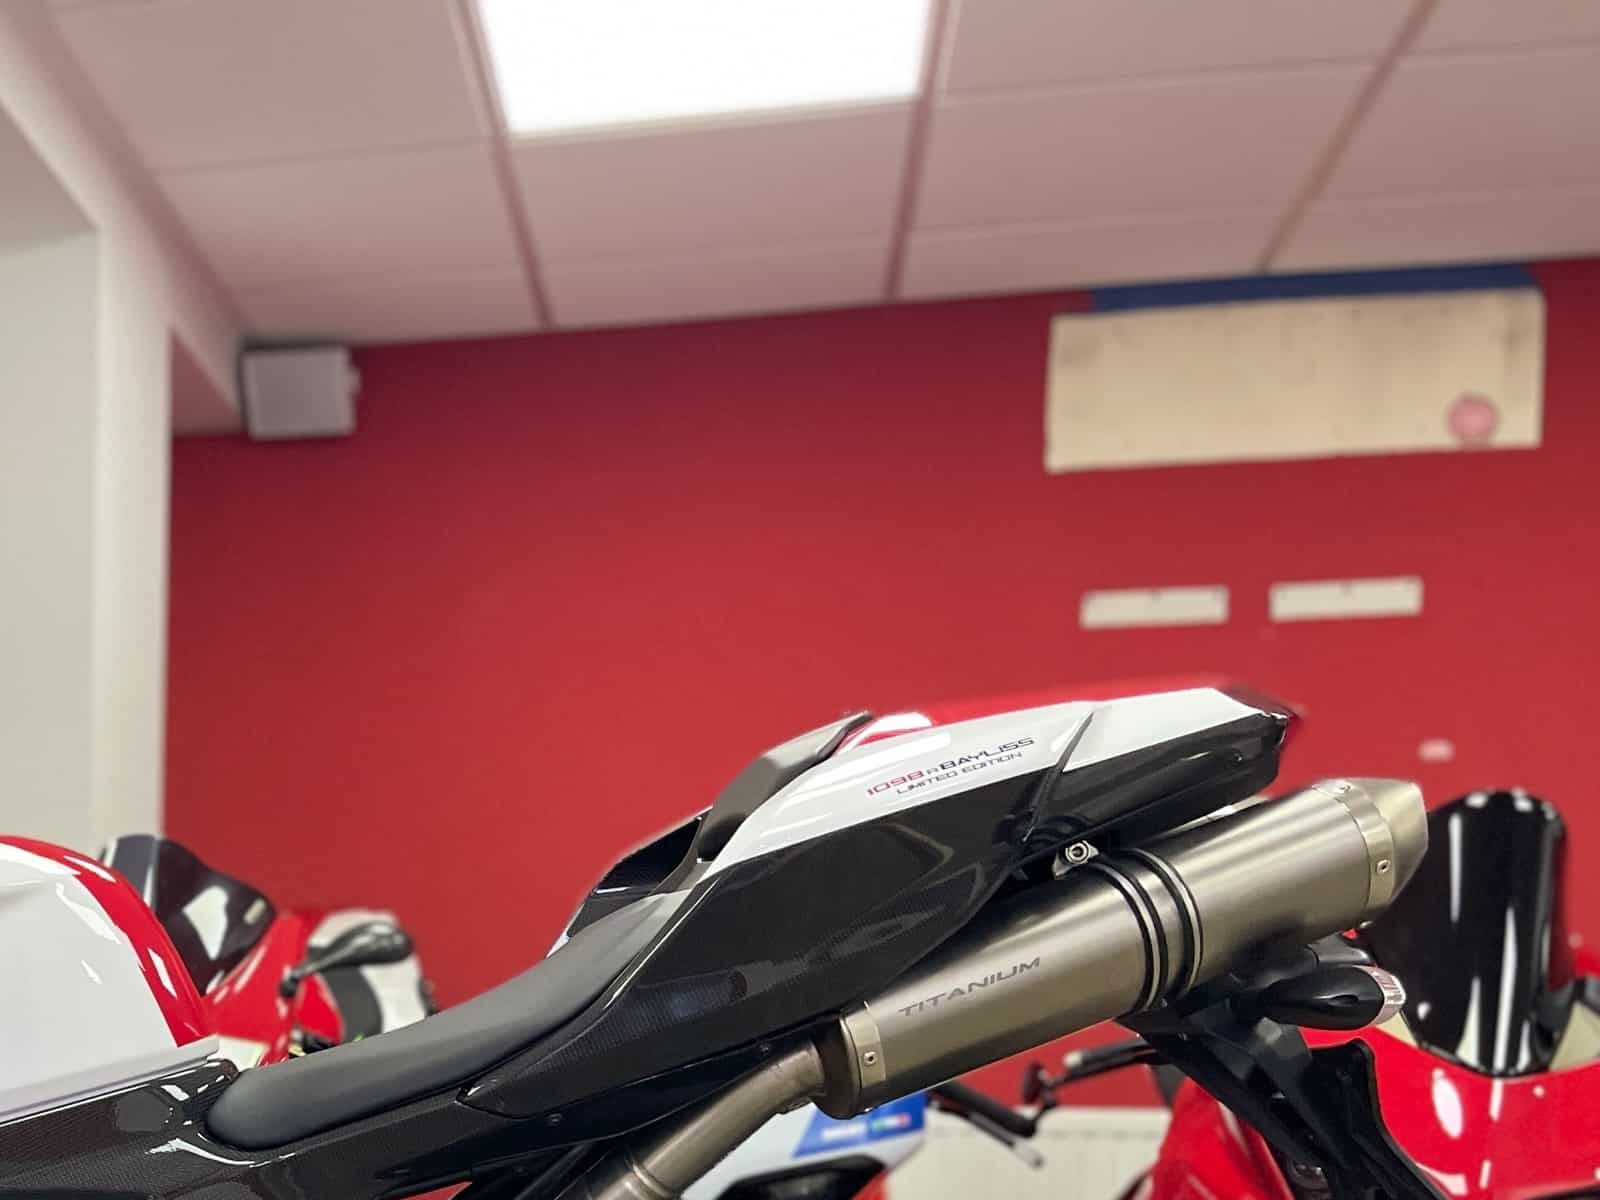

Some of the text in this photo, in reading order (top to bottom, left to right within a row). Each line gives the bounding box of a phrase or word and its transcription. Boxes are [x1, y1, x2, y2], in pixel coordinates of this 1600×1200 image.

[896, 751, 1023, 795] LIMITED EDITION
[939, 736, 1035, 771] BAYLISS
[898, 957, 1041, 1017] TITANIUM
